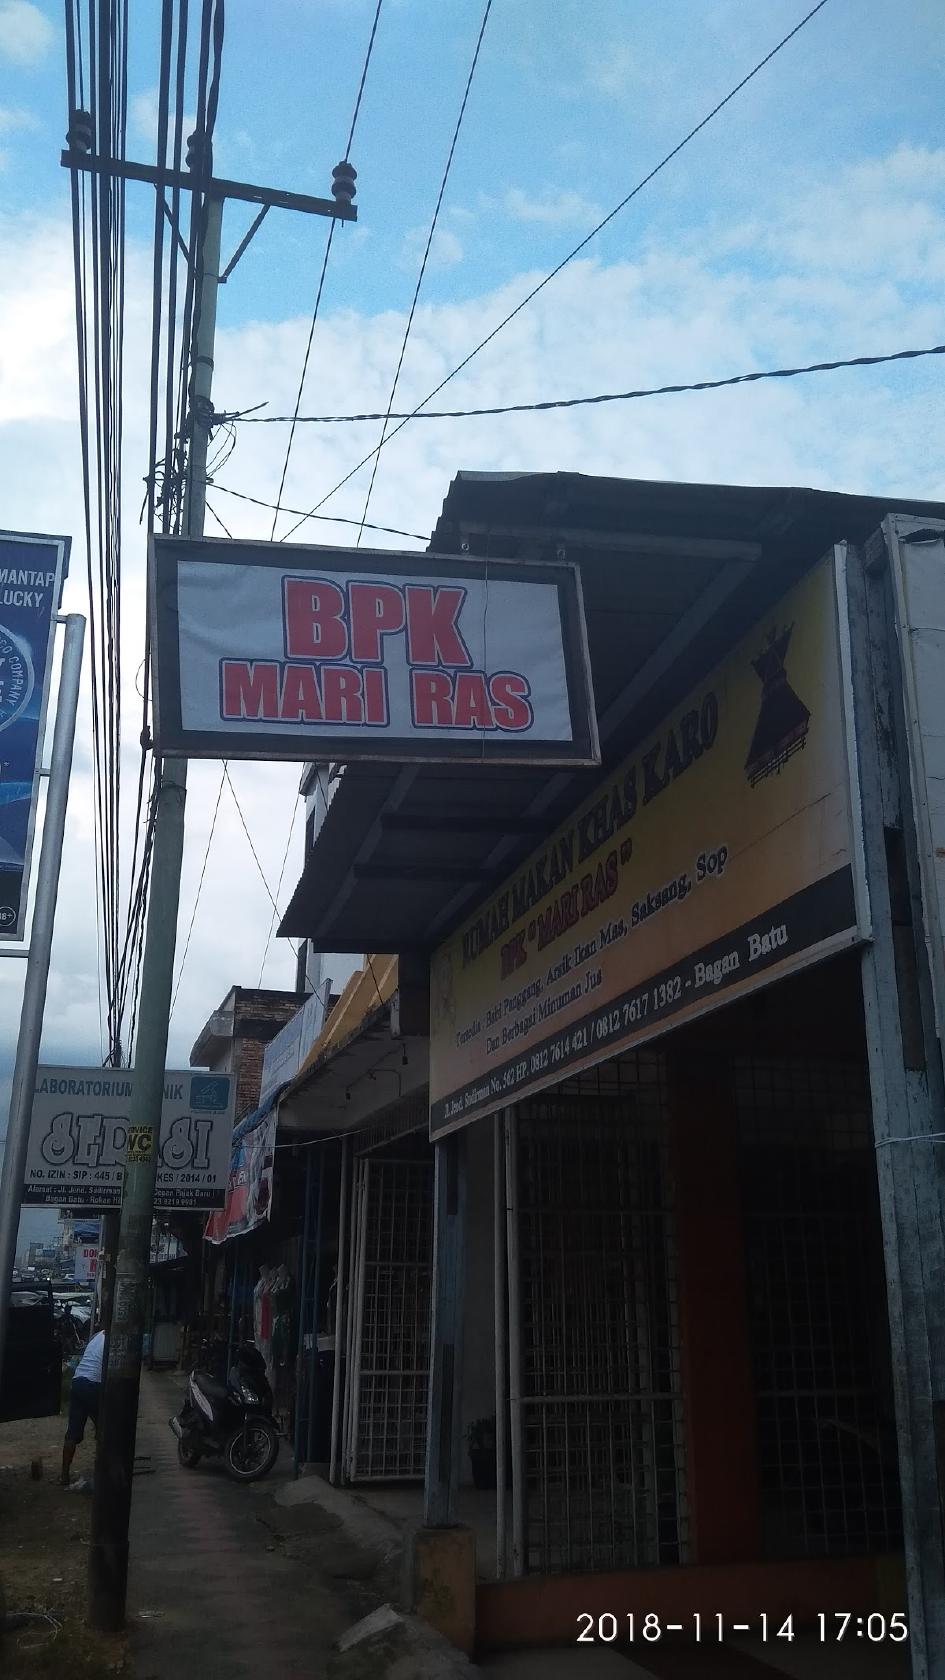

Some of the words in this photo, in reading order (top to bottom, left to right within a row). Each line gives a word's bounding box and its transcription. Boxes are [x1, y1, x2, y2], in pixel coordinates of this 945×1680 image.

[0, 590, 44, 607] UCKY
[281, 574, 473, 669] BPK
[9, 656, 24, 706] COMPANY
[219, 657, 391, 728] MARI
[409, 667, 535, 733] RAS
[462, 889, 510, 968] RUMAH
[511, 829, 574, 922] MAKAN
[577, 766, 638, 864] KHAS
[641, 692, 718, 806] KARO
[574, 941, 597, 967] Ikan
[599, 919, 628, 950] Mas,
[631, 874, 692, 928] Saksang,
[696, 846, 728, 881] Sop
[486, 1036, 500, 1055] Dan
[502, 1008, 536, 1045] Berbagai
[538, 981, 582, 1021] Minuman
[584, 968, 602, 993] Jus
[491, 1077, 502, 1094] No.
[516, 1061, 529, 1082] HP.
[530, 1049, 549, 1072] 0812
[550, 1036, 570, 1063] 7614
[571, 1027, 588, 1051] 421
[596, 1010, 621, 1040] 0812
[622, 993, 649, 1026] 7617
[653, 975, 682, 1010] 1382
[694, 950, 741, 988] Bagan
[747, 924, 789, 962] Batu
[30, 1169, 45, 1179] NO.
[47, 1169, 66, 1179] IZIN
[73, 1170, 88, 1180] SIP
[180, 1174, 200, 1183] 2014
[207, 1174, 217, 1183] 01
